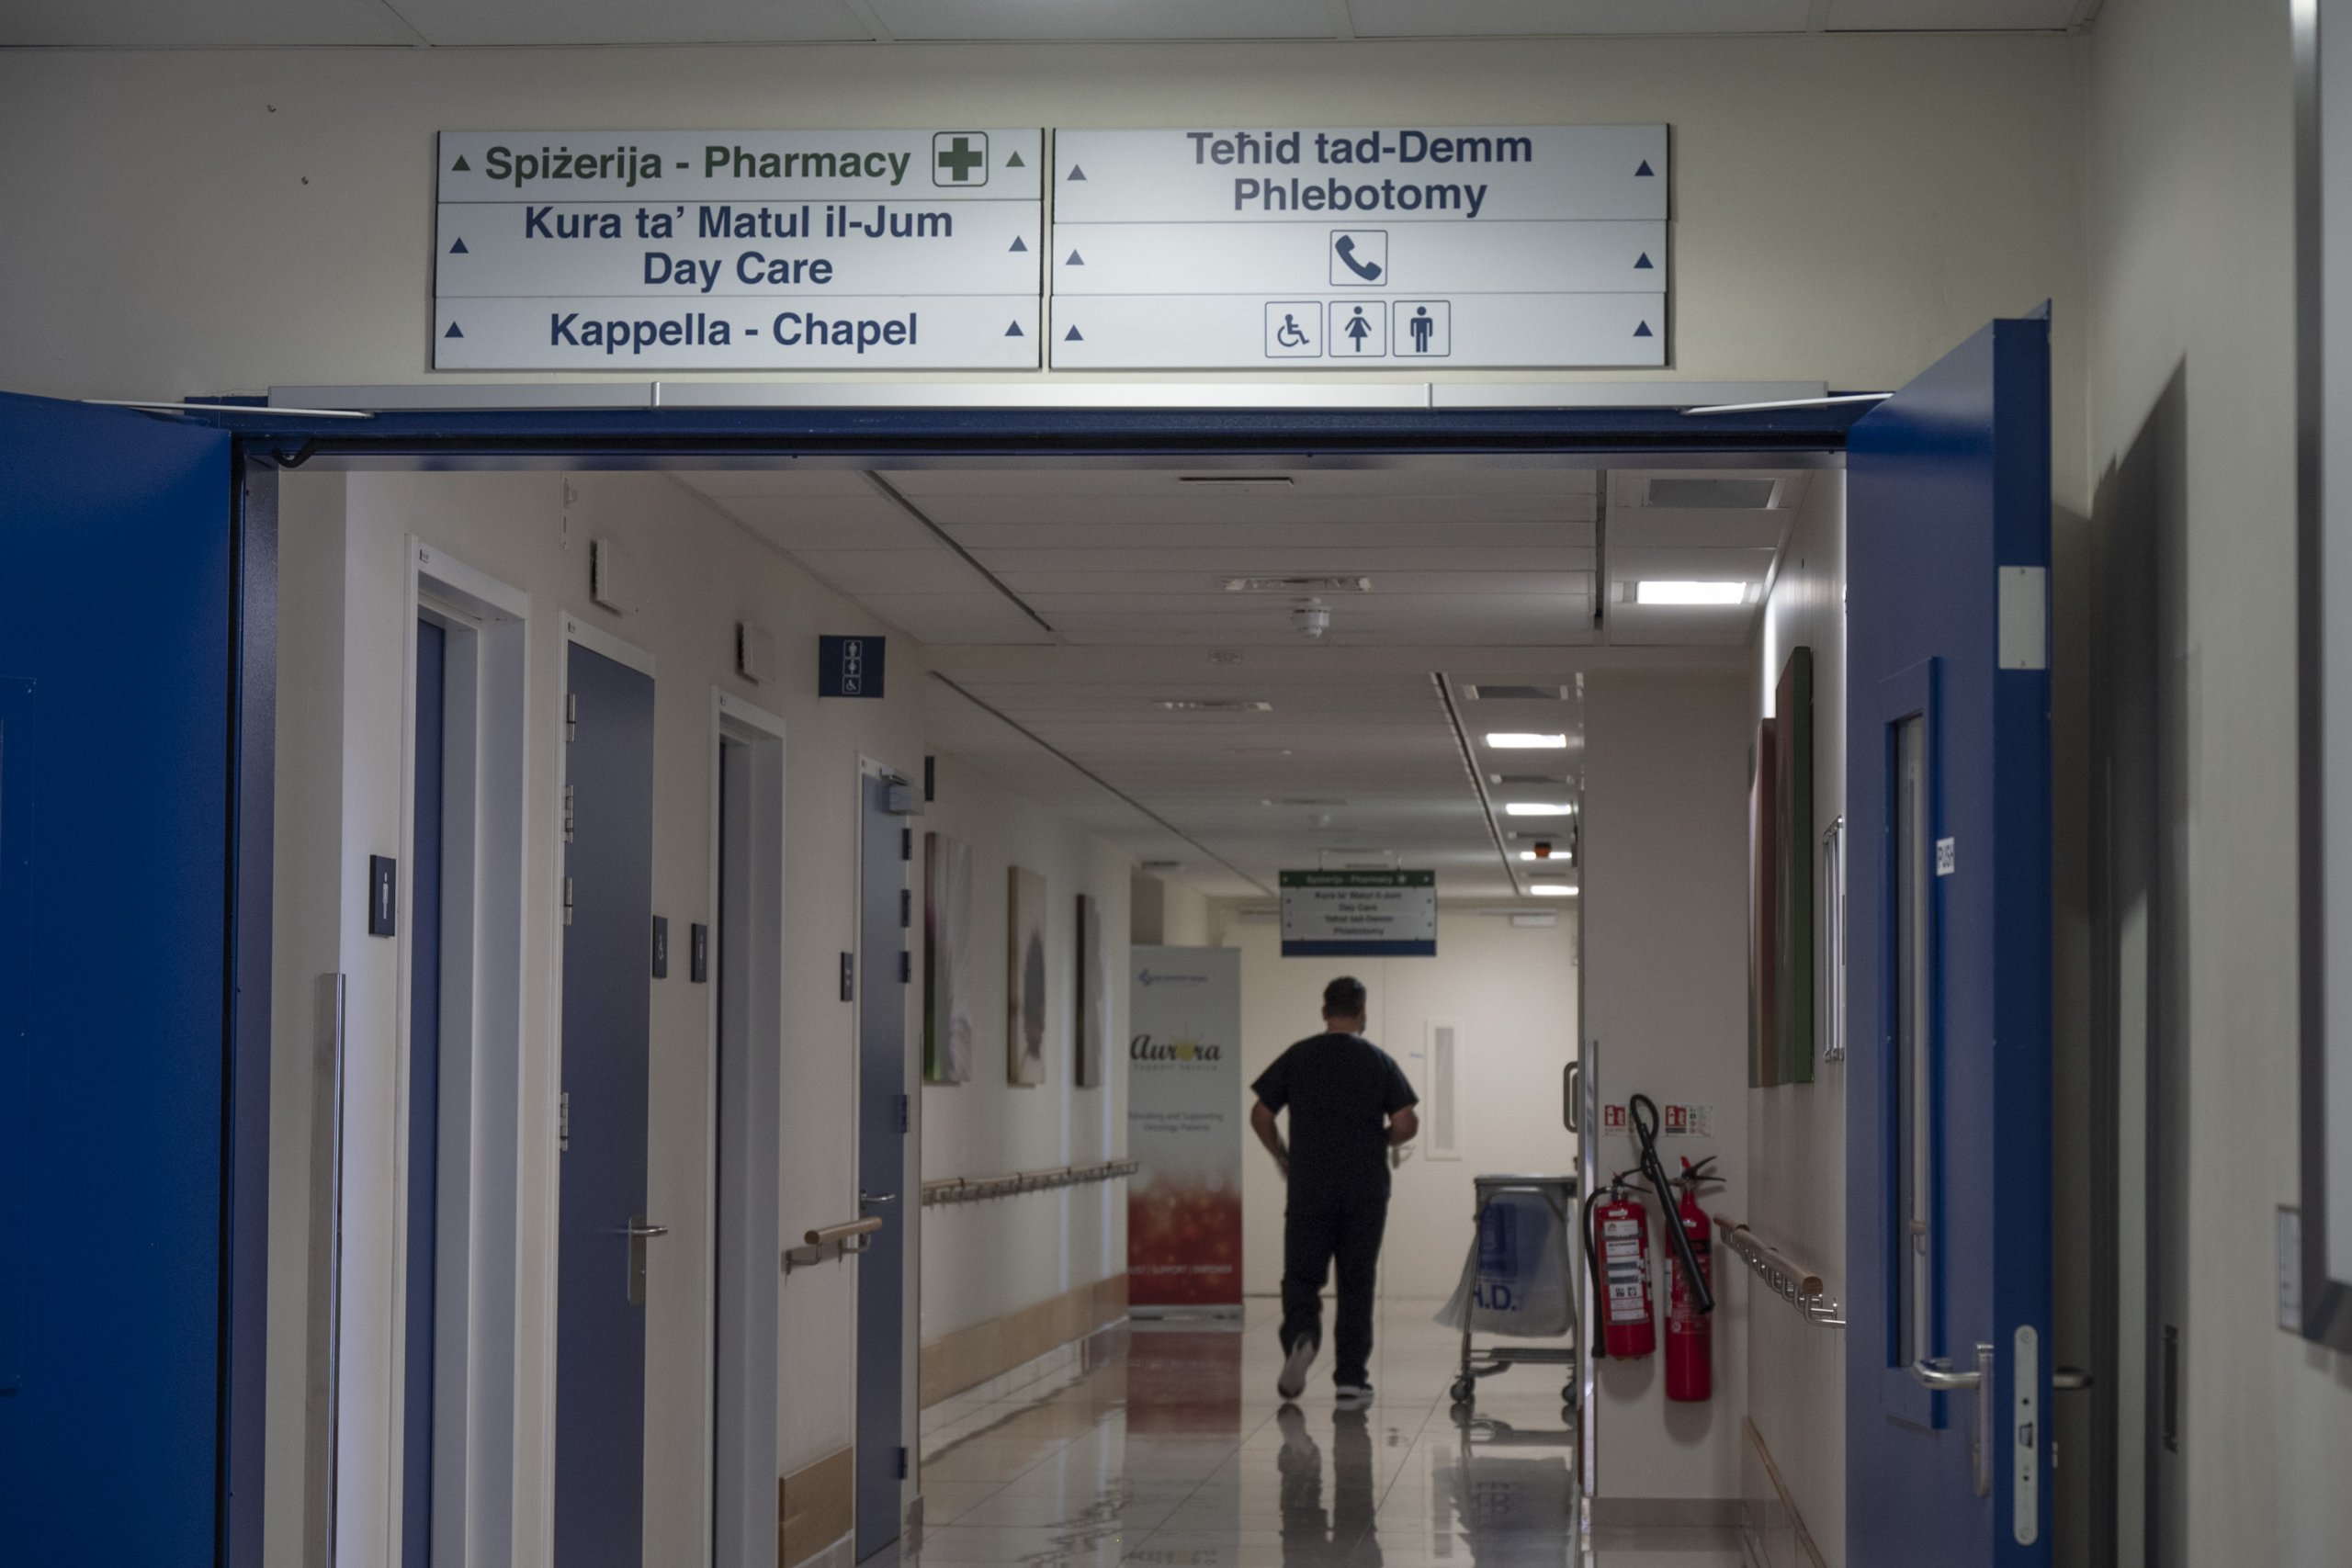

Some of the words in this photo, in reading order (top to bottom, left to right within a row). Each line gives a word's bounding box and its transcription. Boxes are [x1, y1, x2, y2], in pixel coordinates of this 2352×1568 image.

[485, 145, 662, 188] Spiżerija
[705, 145, 911, 187] Pharmacy
[1186, 130, 1301, 165] Teħid
[1314, 130, 1533, 164] tad-Demm
[1233, 177, 1488, 219] Phlebotomy
[525, 206, 623, 239] Kura
[698, 205, 810, 239] Matul
[826, 205, 954, 239] il-Jum
[643, 252, 722, 294] Day
[736, 250, 834, 285] Care
[550, 312, 732, 355] Kappella
[773, 311, 918, 355] Chapel
